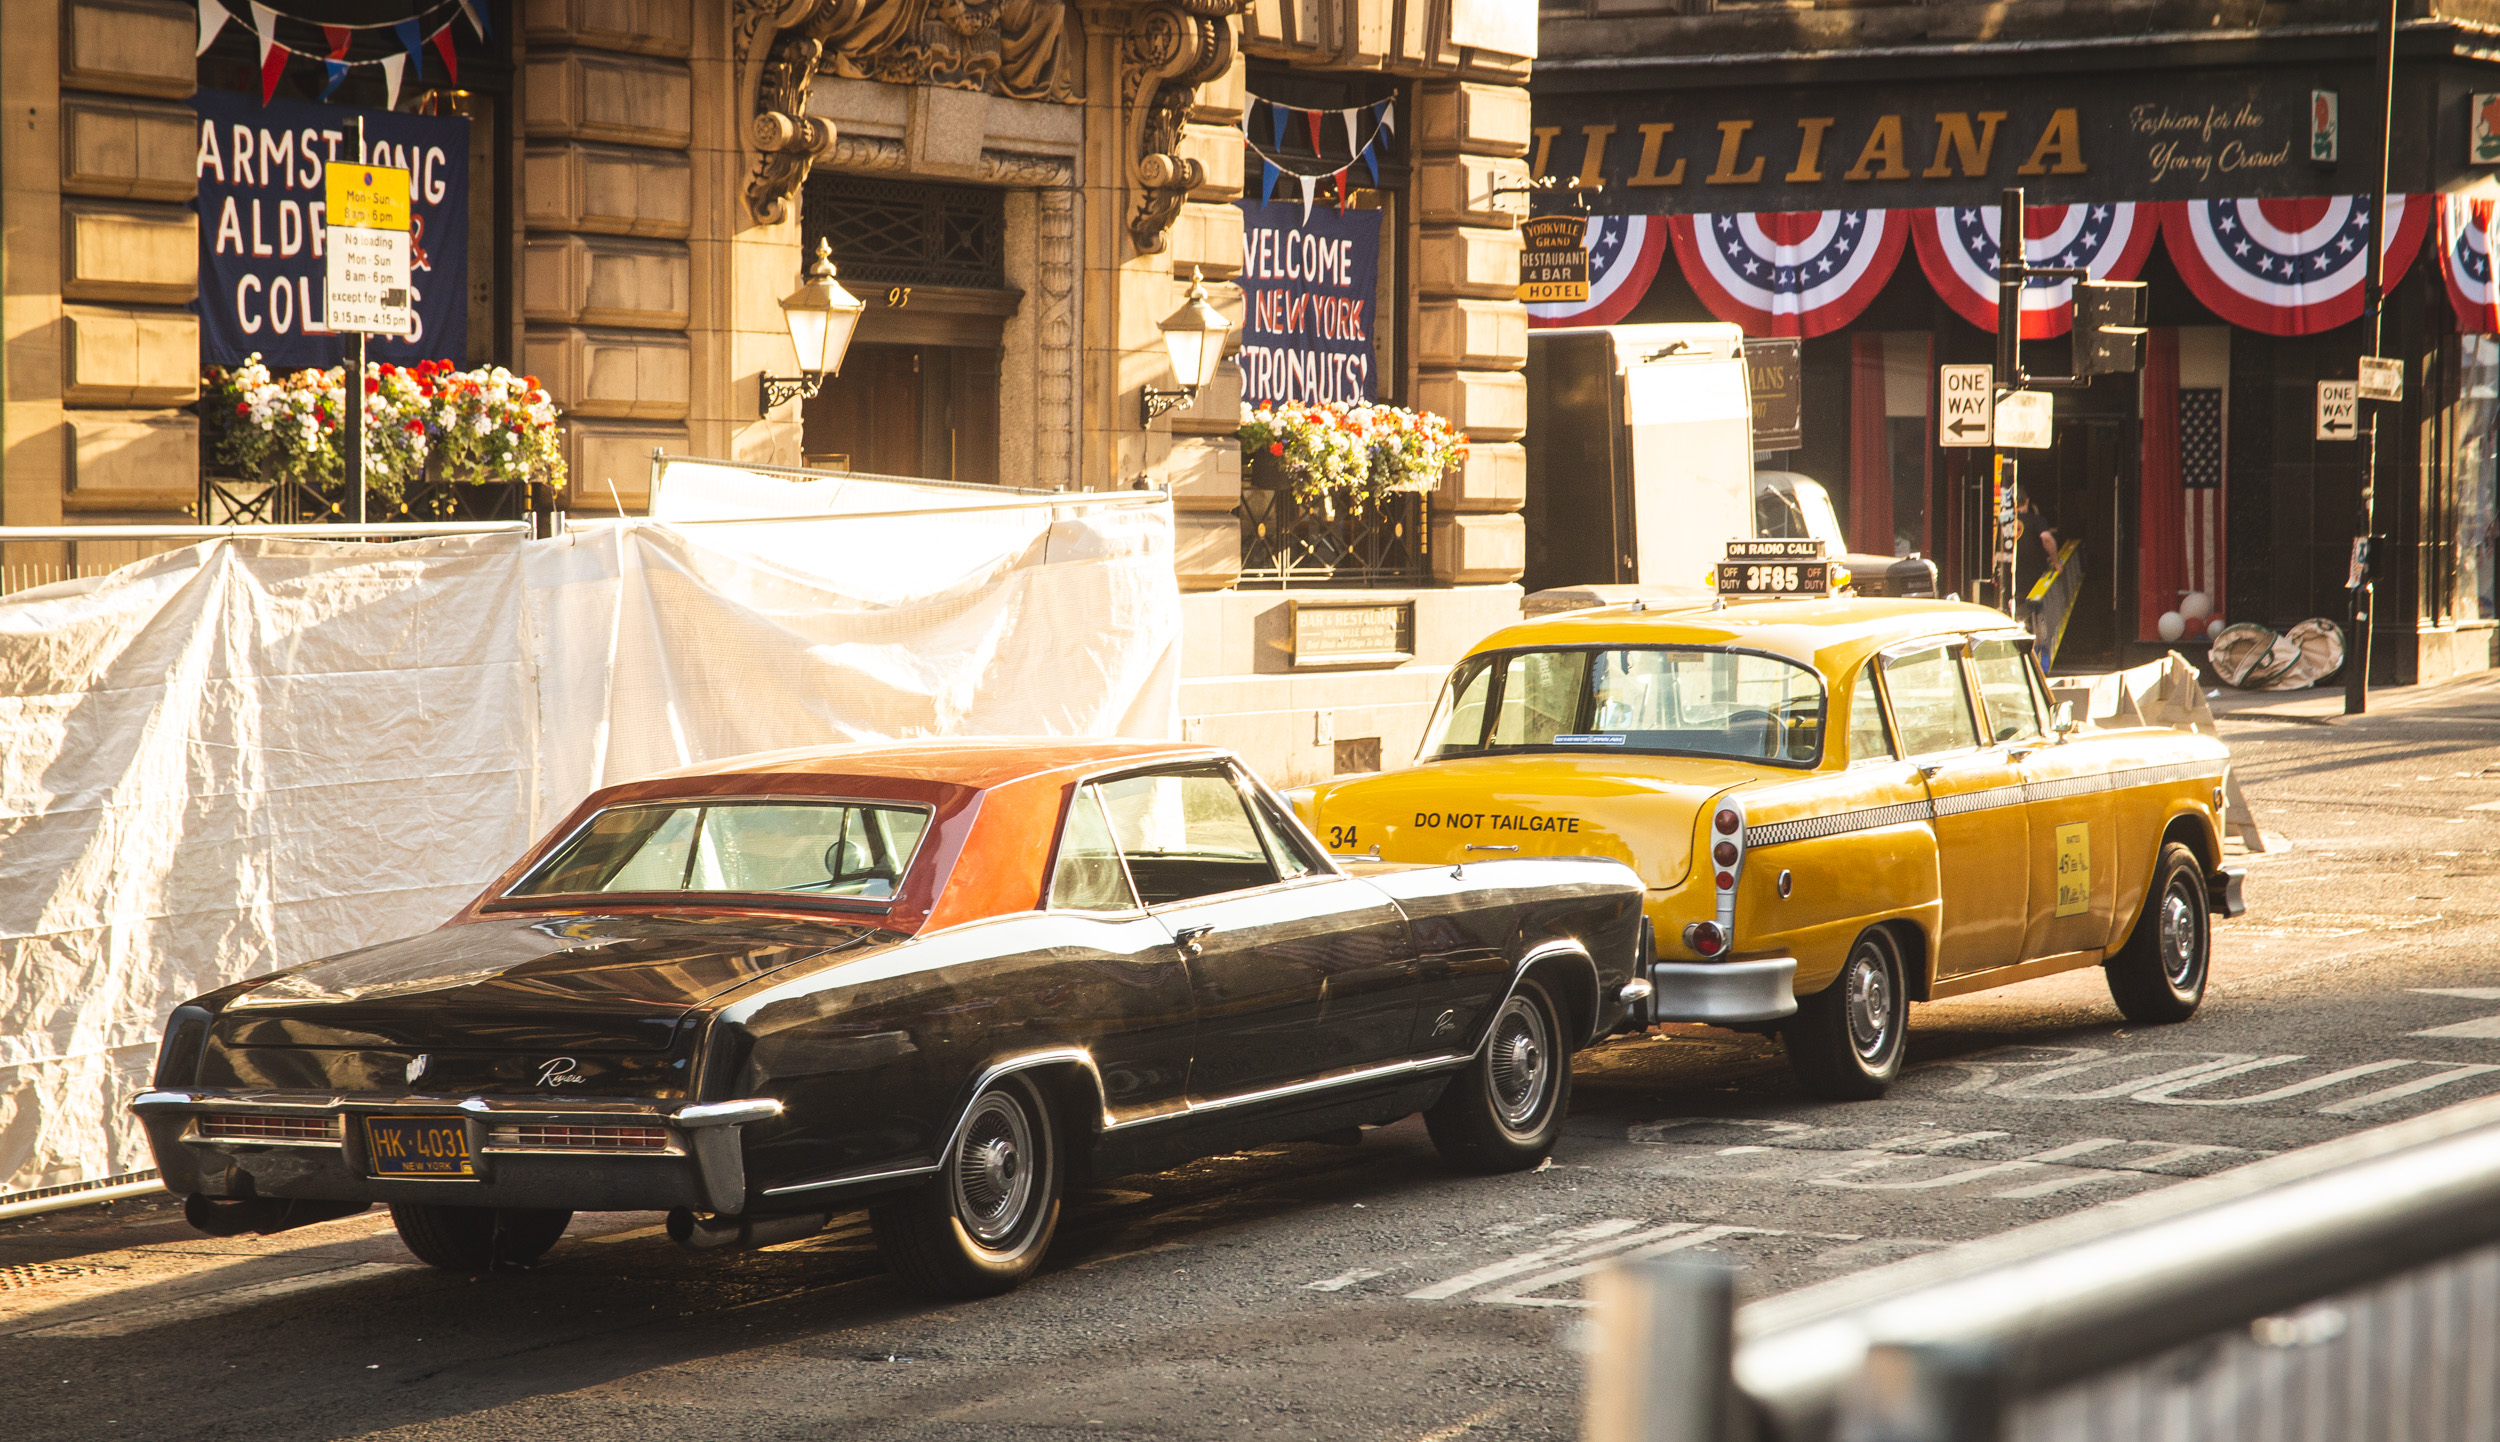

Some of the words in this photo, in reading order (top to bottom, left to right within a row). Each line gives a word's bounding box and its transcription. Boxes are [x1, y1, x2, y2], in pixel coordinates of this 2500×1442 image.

[2130, 102, 2201, 136] Fashion
[2202, 104, 2231, 143] for
[2233, 102, 2264, 128] the
[2149, 140, 2213, 183] Young
[2218, 137, 2291, 173] Crowd
[347, 190, 366, 203] Mon
[373, 193, 391, 205] Sun
[344, 207, 350, 219] 8
[352, 211, 365, 220] am
[372, 210, 378, 221] 6
[380, 214, 393, 223] pm
[216, 196, 326, 259] ALDR
[1525, 222, 1580, 238] YORKVILLE
[345, 234, 358, 246] No
[361, 235, 393, 250] loading
[1536, 237, 1571, 247] GRAND
[347, 253, 367, 264] Mon
[374, 254, 391, 266] Sun
[1522, 251, 1585, 267] RESTAURANT
[345, 269, 351, 281] 8
[353, 273, 366, 282] am
[373, 271, 379, 283] 6
[380, 275, 393, 284] pm
[1529, 269, 1537, 279] &
[1542, 267, 1571, 280] BAR
[332, 290, 361, 304] except
[364, 292, 377, 303] for
[888, 287, 911, 308] 93
[1529, 285, 1581, 297] HOTEL
[237, 273, 424, 344] COLS
[1255, 288, 1309, 335] NEW
[1313, 293, 1366, 342] YORK
[333, 311, 351, 324] 9.15
[353, 315, 366, 324] am
[373, 314, 391, 325] 4.15
[393, 316, 406, 326] pm
[1235, 344, 1368, 408] STRONAUTS!
[1948, 374, 1985, 391] ONE
[2323, 387, 2352, 400] ONE
[1948, 397, 1986, 414] WAY
[2322, 403, 2353, 417] WAY
[1728, 544, 1745, 555] ON
[1748, 543, 1785, 555] RADIO
[1787, 543, 1816, 555] CALL
[1723, 567, 1738, 578] OFF
[1746, 566, 1799, 591] 3F85
[1807, 567, 1822, 578] OFF
[1721, 579, 1740, 590] DUTY
[1804, 579, 1825, 590] DUTY
[1300, 613, 1324, 627] BAR
[1335, 610, 1406, 627] RESTAURANT
[1414, 812, 1441, 828] DO
[1446, 812, 1485, 829] NOT
[1490, 814, 1580, 834] TAILGATE
[1329, 825, 1358, 849] 34
[402, 1162, 424, 1171] NEW
[426, 1162, 452, 1171] YORK
